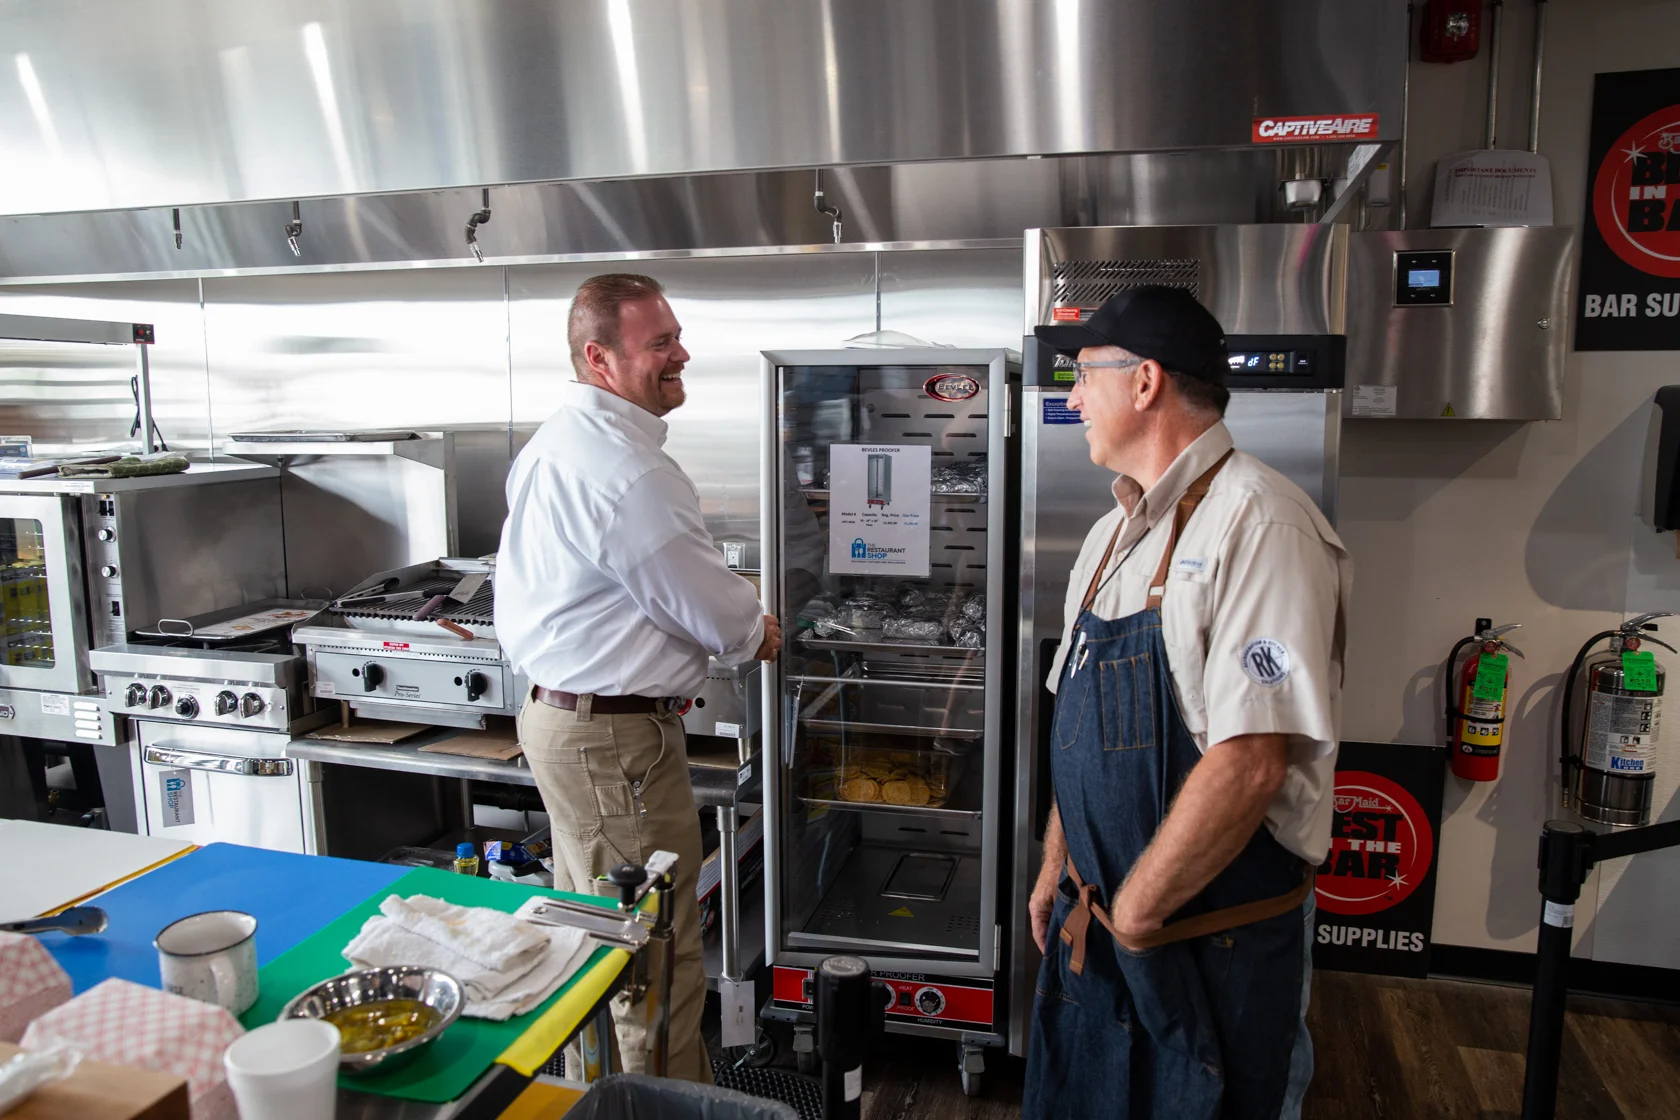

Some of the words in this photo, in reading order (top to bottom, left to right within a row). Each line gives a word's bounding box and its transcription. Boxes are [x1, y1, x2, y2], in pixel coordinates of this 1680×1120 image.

[1258, 118, 1373, 137] CAPTIVEAIRE
[1629, 185, 1667, 200] IN
[1584, 294, 1638, 318] BAR
[1251, 646, 1281, 678] RK
[1611, 756, 1644, 770] Kitchen
[1354, 796, 1379, 808] Maid
[1332, 811, 1403, 843] EST
[1347, 838, 1402, 854] THE
[1317, 924, 1425, 952] SUPPLIES
[880, 971, 925, 982] PROOFER
[917, 1017, 943, 1025] HUMIDITY
